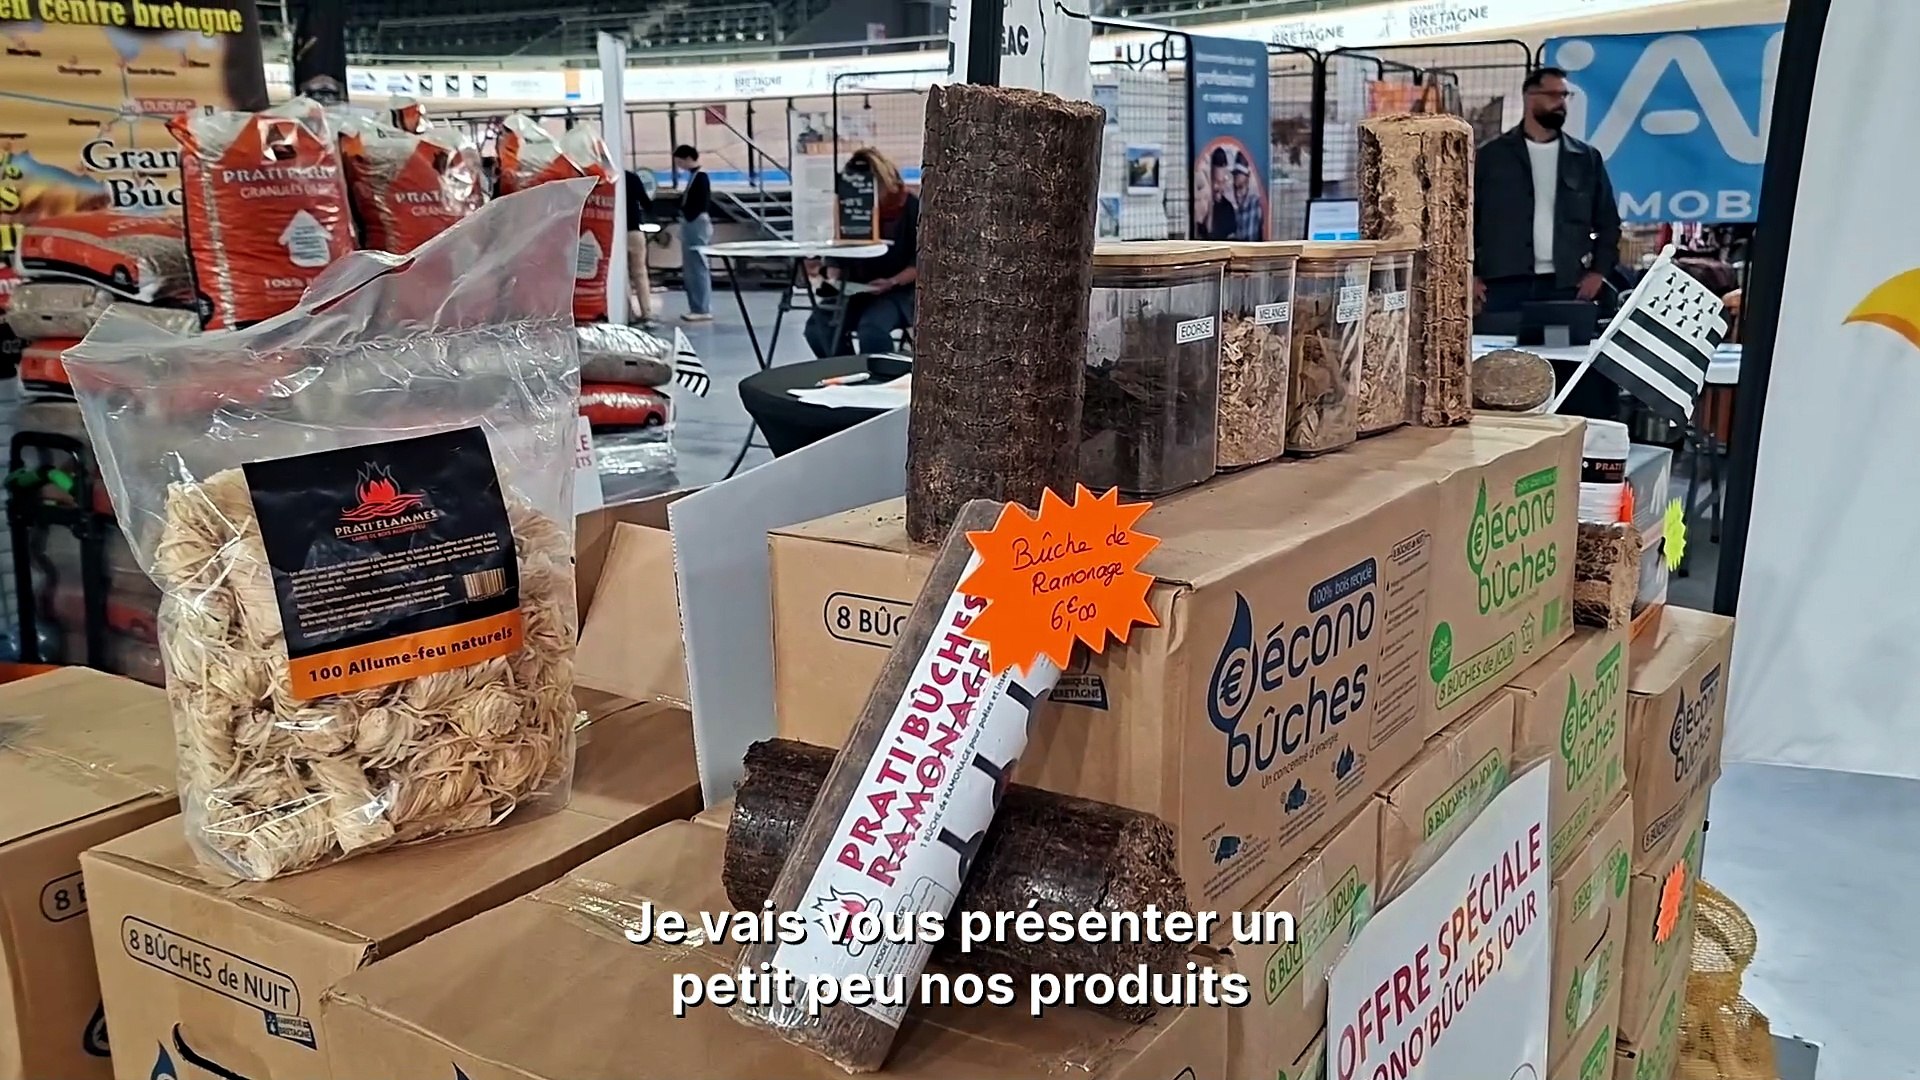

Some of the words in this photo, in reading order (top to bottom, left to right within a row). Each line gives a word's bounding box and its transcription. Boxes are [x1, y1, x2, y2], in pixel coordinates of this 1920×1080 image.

[0, 0, 31, 20] en
[39, 0, 128, 26] centre
[133, 0, 244, 37] bretagne
[1409, 5, 1489, 28] BRETAGNE
[1272, 26, 1345, 45] BRETAGNE
[83, 140, 180, 171] Gran
[108, 179, 184, 207] Bûc
[1618, 190, 1752, 219] MOB
[1259, 306, 1287, 320] MELANGE
[334, 509, 439, 537] PRATI'FLAMMES
[1012, 530, 1093, 571] Bûche
[1105, 524, 1130, 546] de
[1031, 560, 1124, 595] Ramonage
[1313, 584, 1333, 606] 100%
[1335, 576, 1350, 595] bois
[1478, 542, 1557, 615] bûches
[837, 606, 851, 629] 8
[859, 604, 907, 637] BÛC
[309, 666, 343, 682] 100
[348, 644, 447, 676] Allume-feu
[450, 626, 514, 653] naturels
[1261, 591, 1375, 692] écono
[1447, 661, 1481, 697] BÛCHES
[1226, 662, 1369, 788] bûches
[924, 811, 942, 843] BÛCHE
[944, 748, 973, 801] RAMONAGE
[969, 727, 982, 751] pour
[980, 701, 995, 731] poêles
[990, 688, 1000, 703] et
[1262, 773, 1273, 789] Un
[54, 889, 71, 912] 8
[1269, 969, 1276, 995] 8
[1331, 878, 1356, 928] JOUR
[1337, 943, 1432, 1080] OFFRE
[1438, 822, 1541, 980] SPÉCIALE
[129, 928, 140, 951] 8
[144, 933, 212, 980] BÛCHES
[218, 961, 239, 989] de
[244, 975, 291, 1010] NUIT
[1368, 937, 1494, 1080] ONO'BÛCHES
[1498, 889, 1537, 973] JOUR
